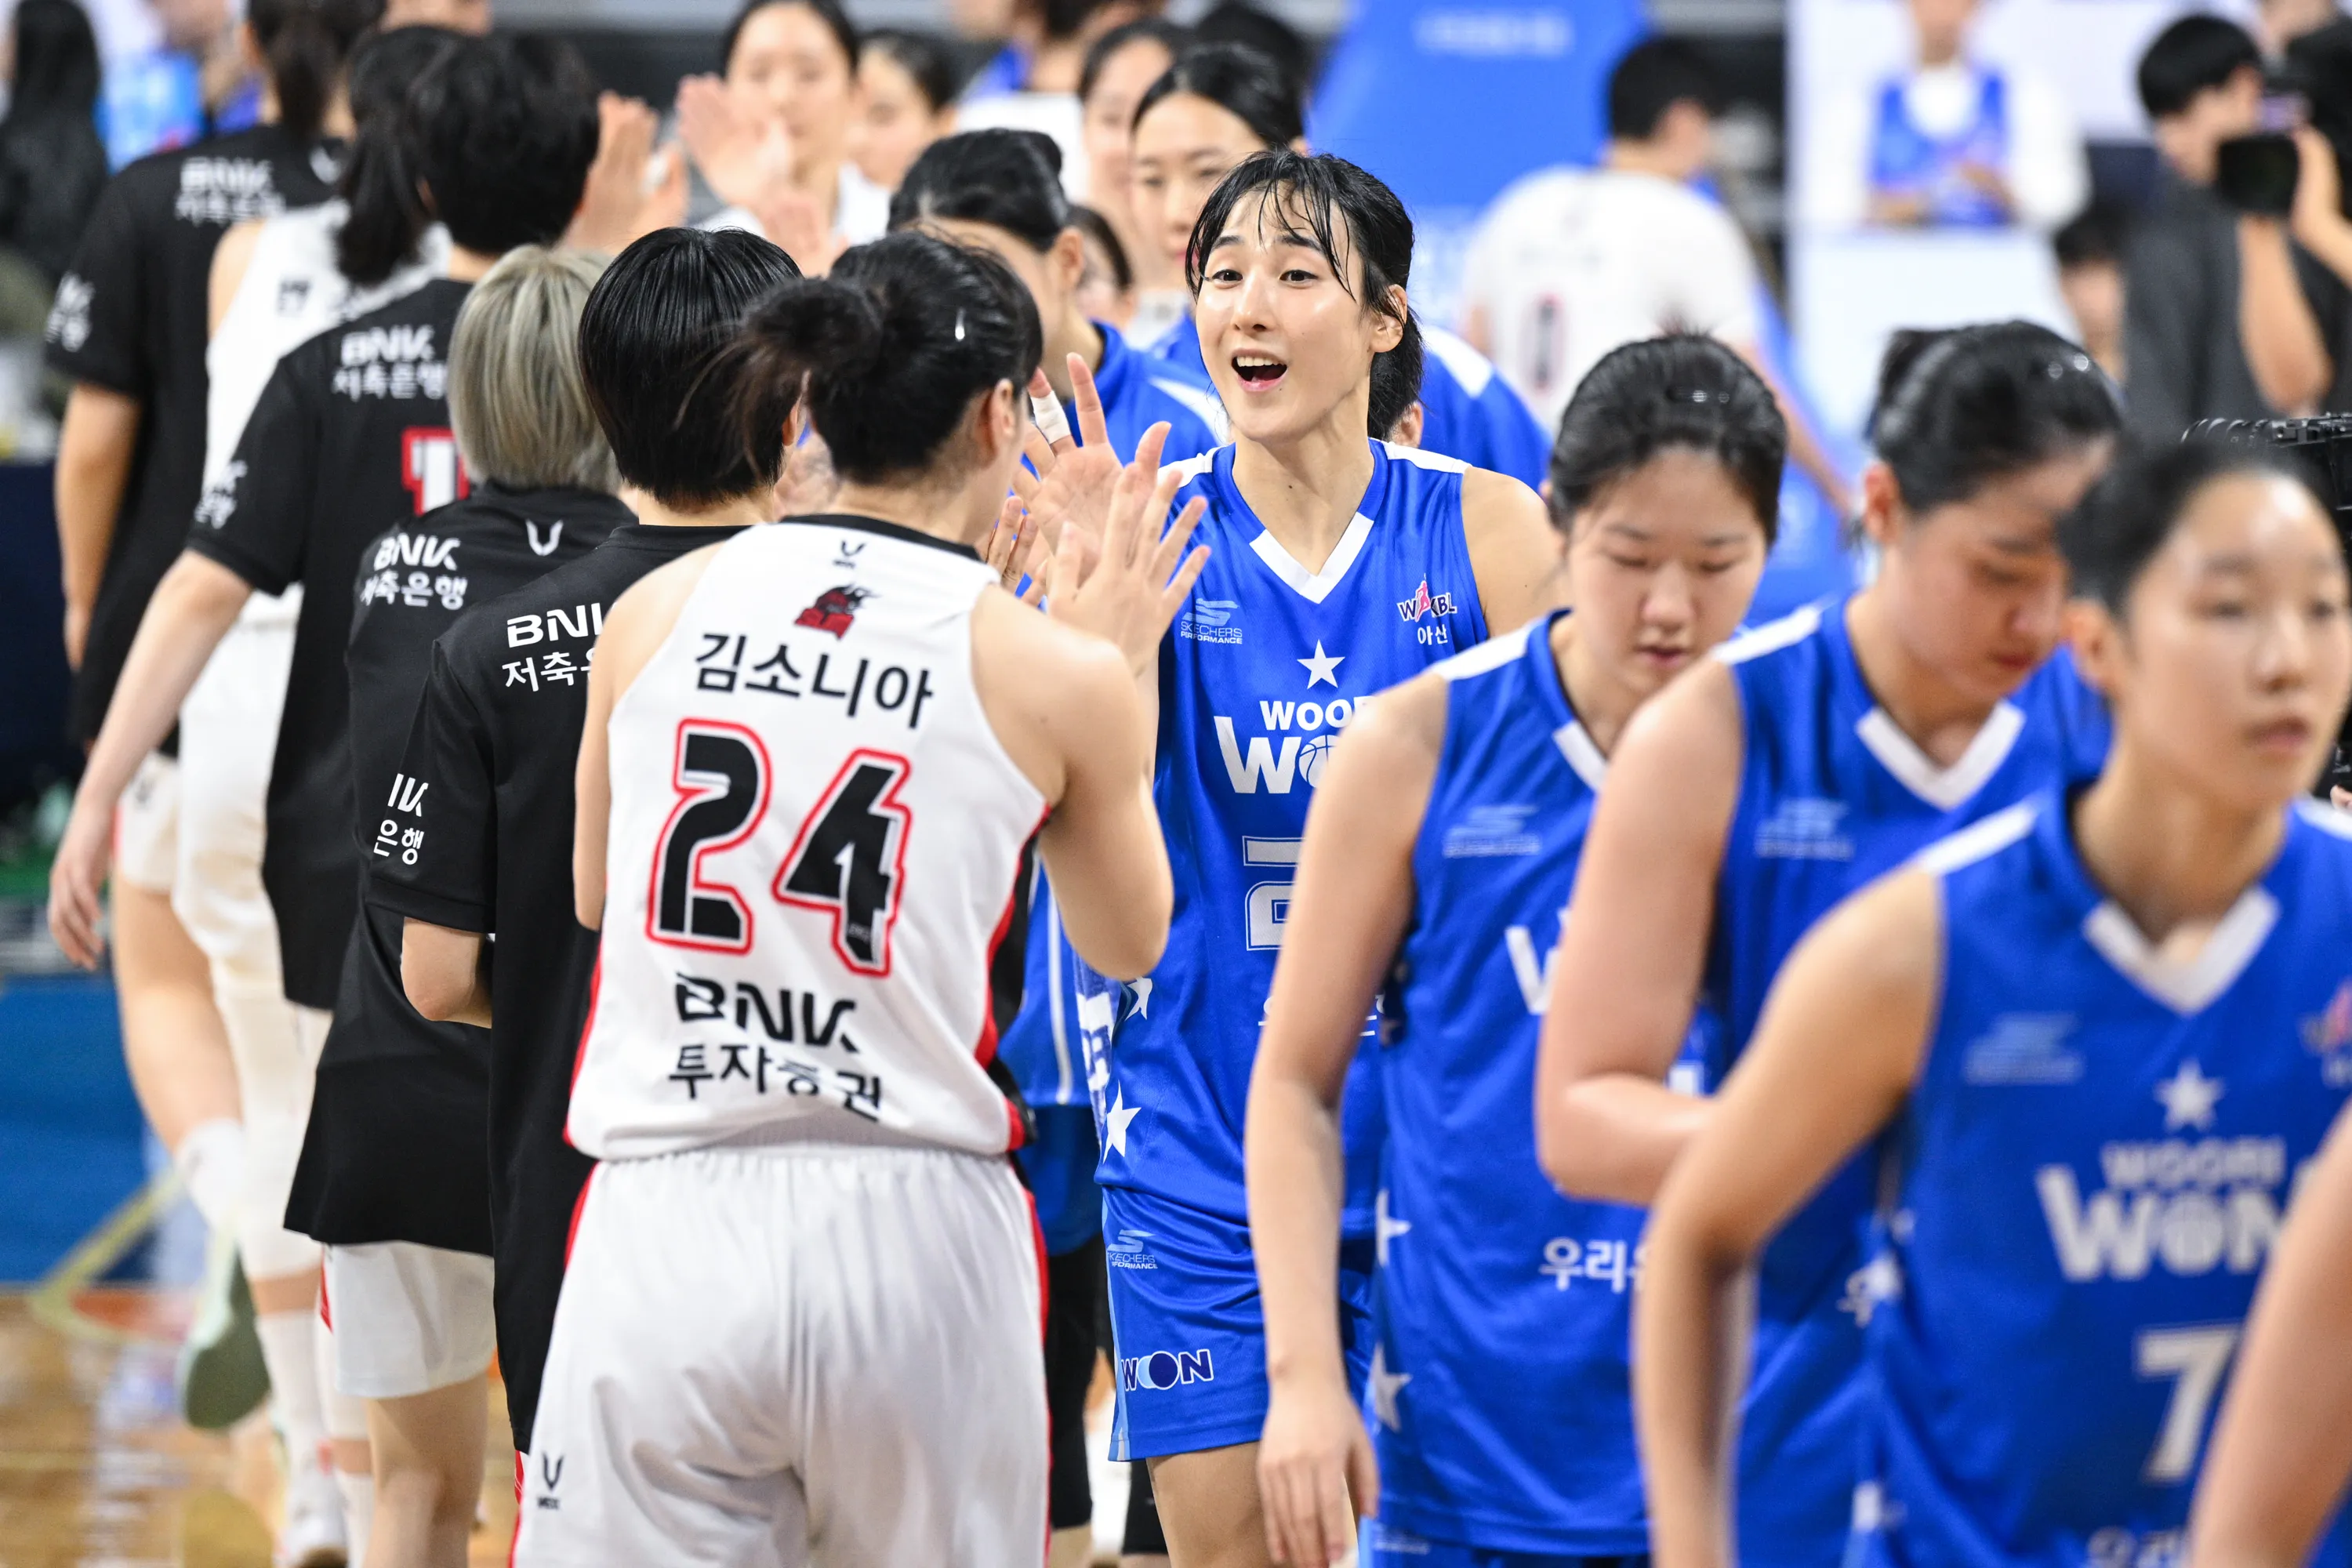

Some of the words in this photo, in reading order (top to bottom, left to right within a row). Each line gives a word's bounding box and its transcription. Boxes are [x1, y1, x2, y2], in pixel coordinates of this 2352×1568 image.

[341, 324, 435, 366] BNK
[374, 533, 460, 571] BNK
[1180, 621, 1243, 638] SKECHERS
[1180, 630, 1243, 644] PERFORMANCE
[1417, 624, 1448, 645] 아산
[695, 633, 933, 729] 김소니아
[373, 819, 424, 865] 은행
[647, 718, 912, 977] 24
[675, 971, 859, 1054] BNK
[2134, 1319, 2242, 1486] 7
